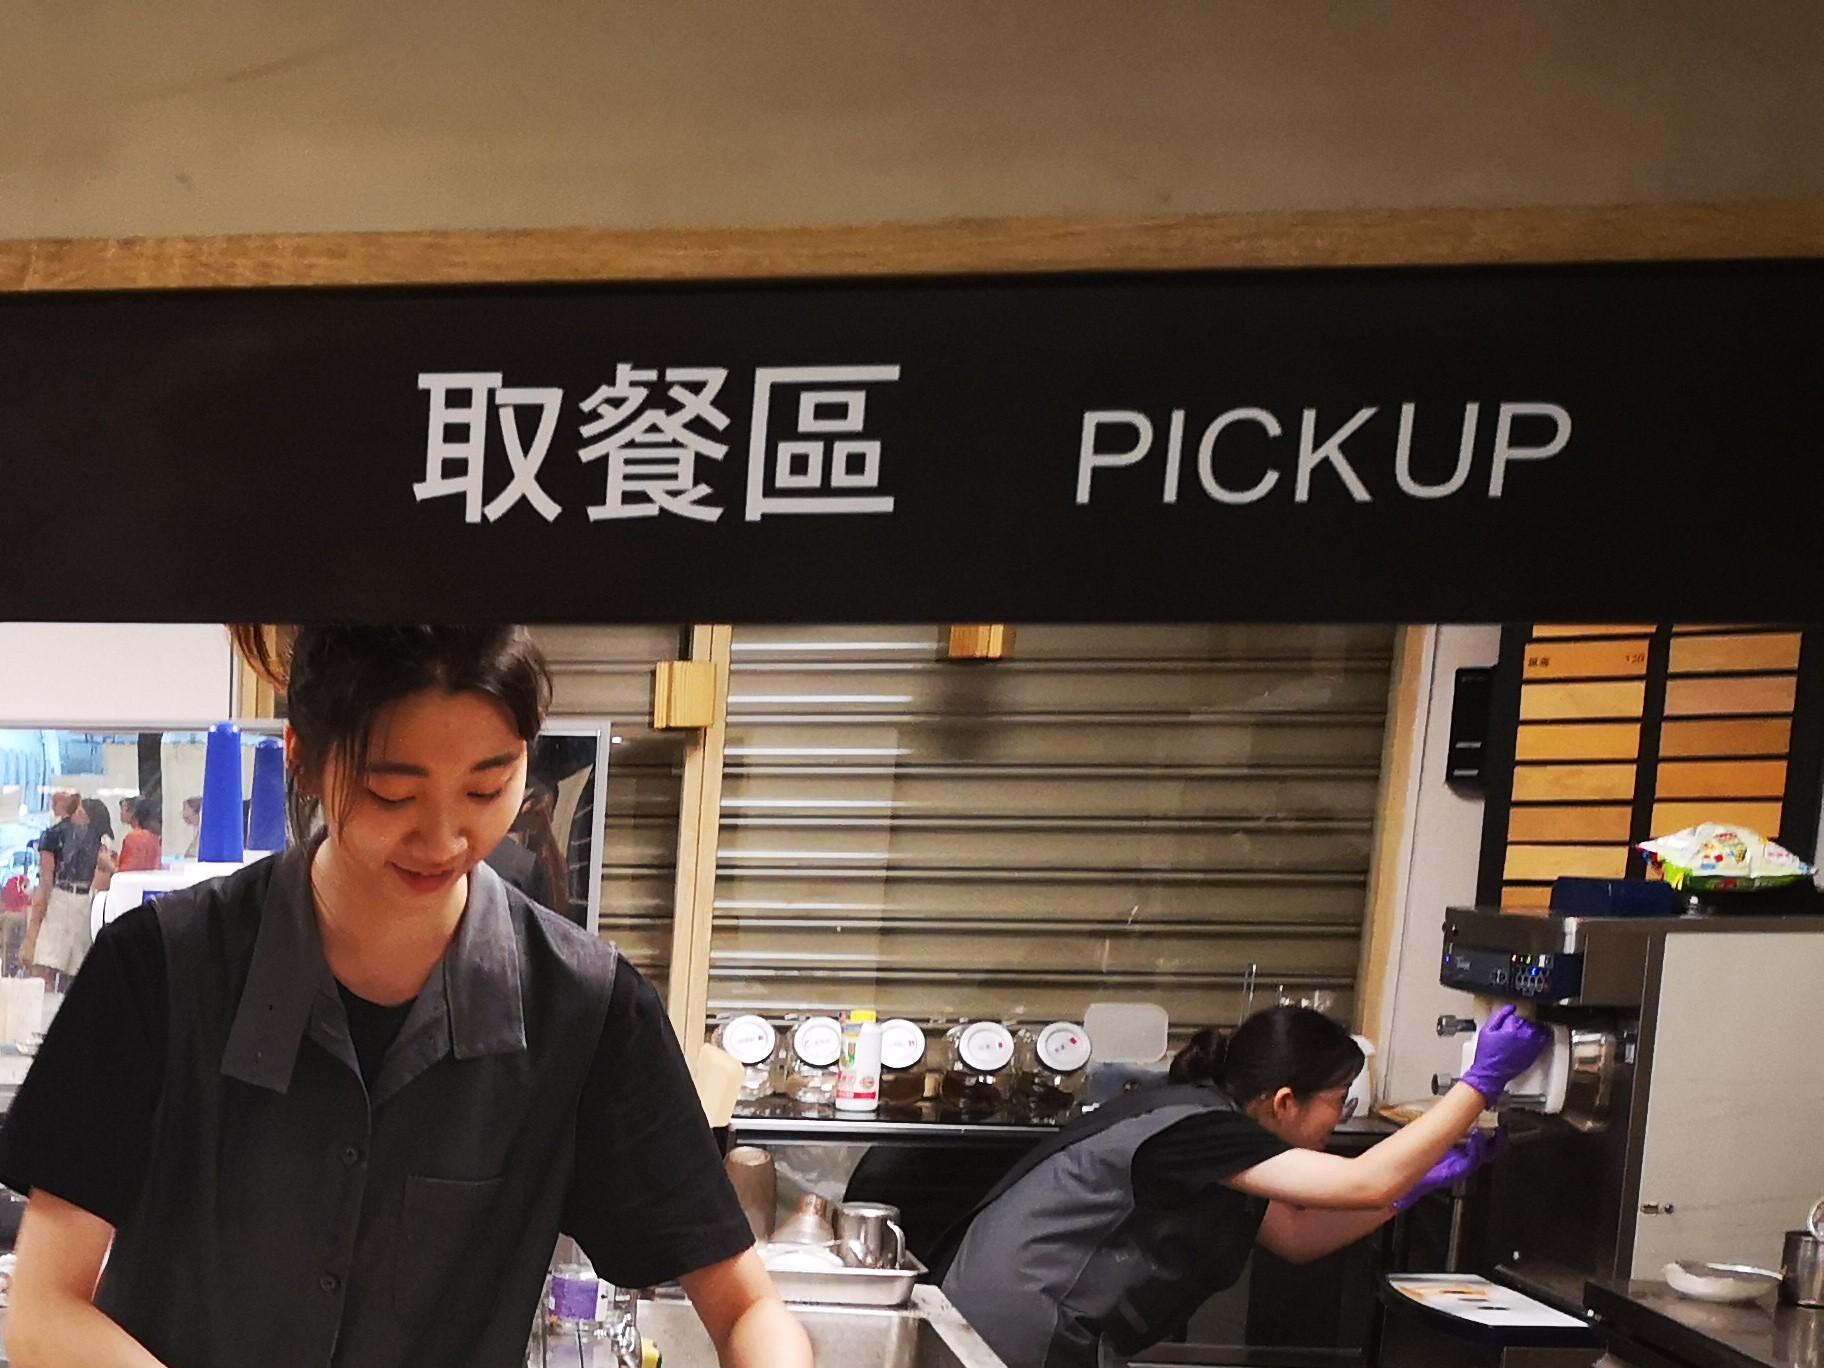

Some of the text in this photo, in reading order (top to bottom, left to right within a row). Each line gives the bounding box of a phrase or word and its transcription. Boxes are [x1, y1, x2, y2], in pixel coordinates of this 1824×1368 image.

[414, 363, 901, 525] 取餐區
[1076, 401, 1574, 505] PICKUP
